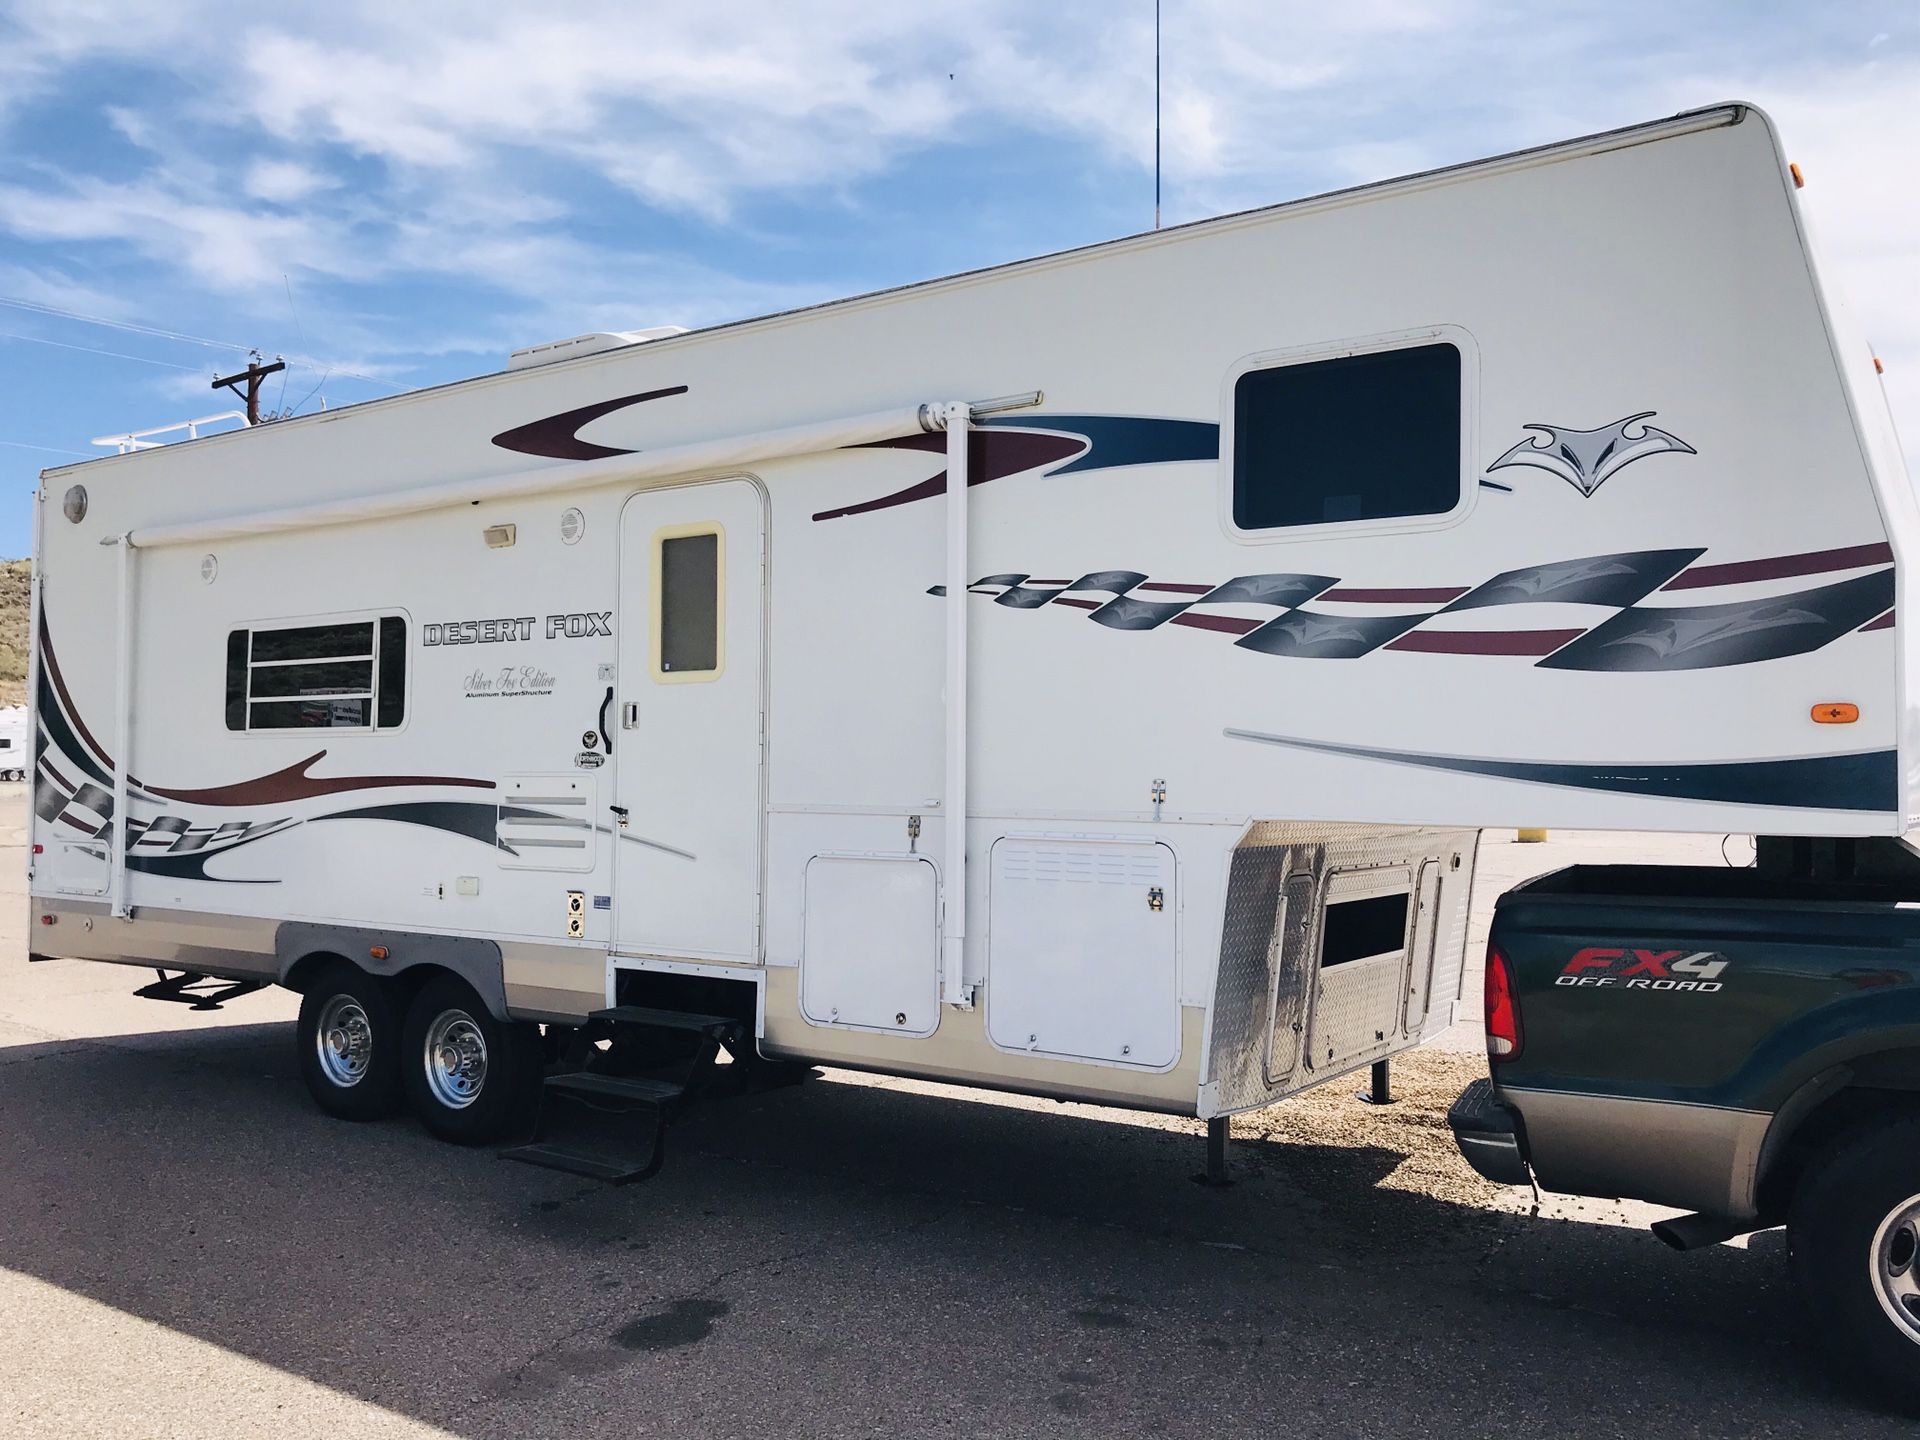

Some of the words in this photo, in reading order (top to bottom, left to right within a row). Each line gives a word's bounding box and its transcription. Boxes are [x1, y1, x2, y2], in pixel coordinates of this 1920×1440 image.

[423, 617, 536, 646] DESERT
[545, 611, 612, 639] FOX
[464, 669, 492, 691] Silver
[496, 667, 517, 691] Fox
[520, 665, 556, 689] Edition
[1563, 947, 1729, 979] FX4
[1555, 976, 1617, 987] OFF
[1626, 979, 1723, 992] ROAD
